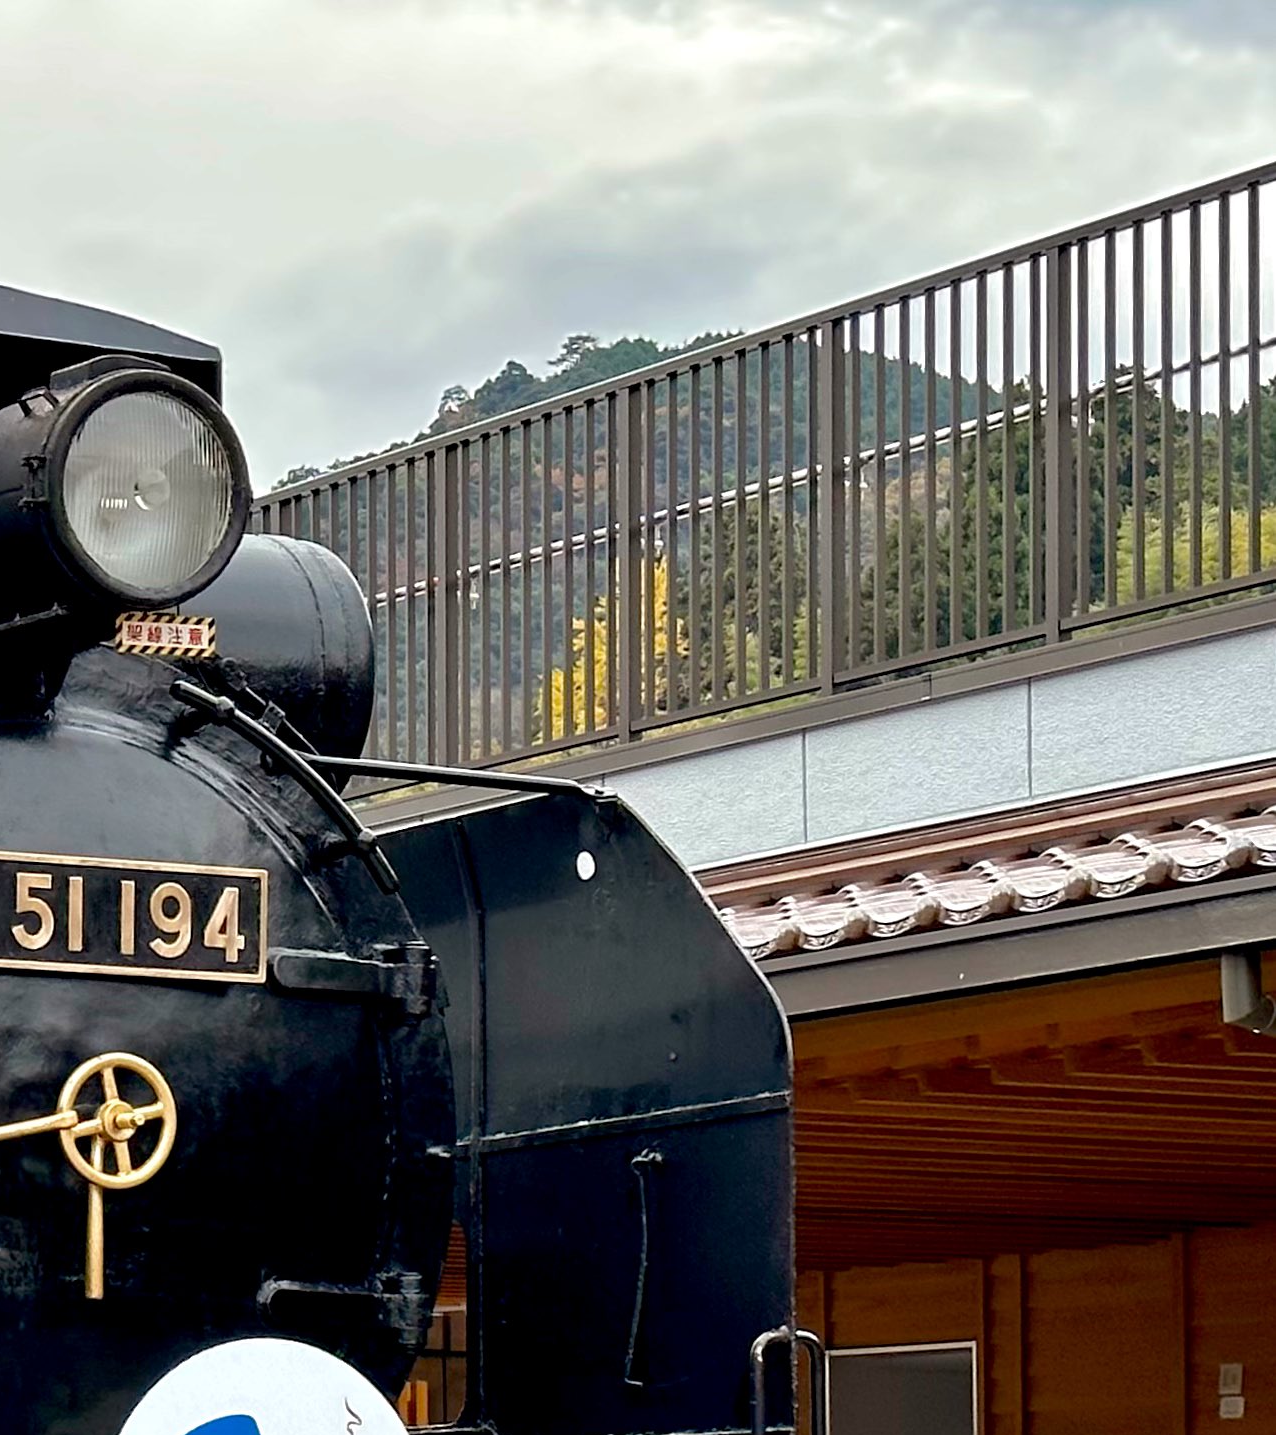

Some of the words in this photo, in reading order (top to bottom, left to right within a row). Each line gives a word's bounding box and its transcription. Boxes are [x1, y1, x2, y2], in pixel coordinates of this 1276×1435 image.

[126, 624, 203, 645] 架線注意
[120, 880, 245, 962] 194
